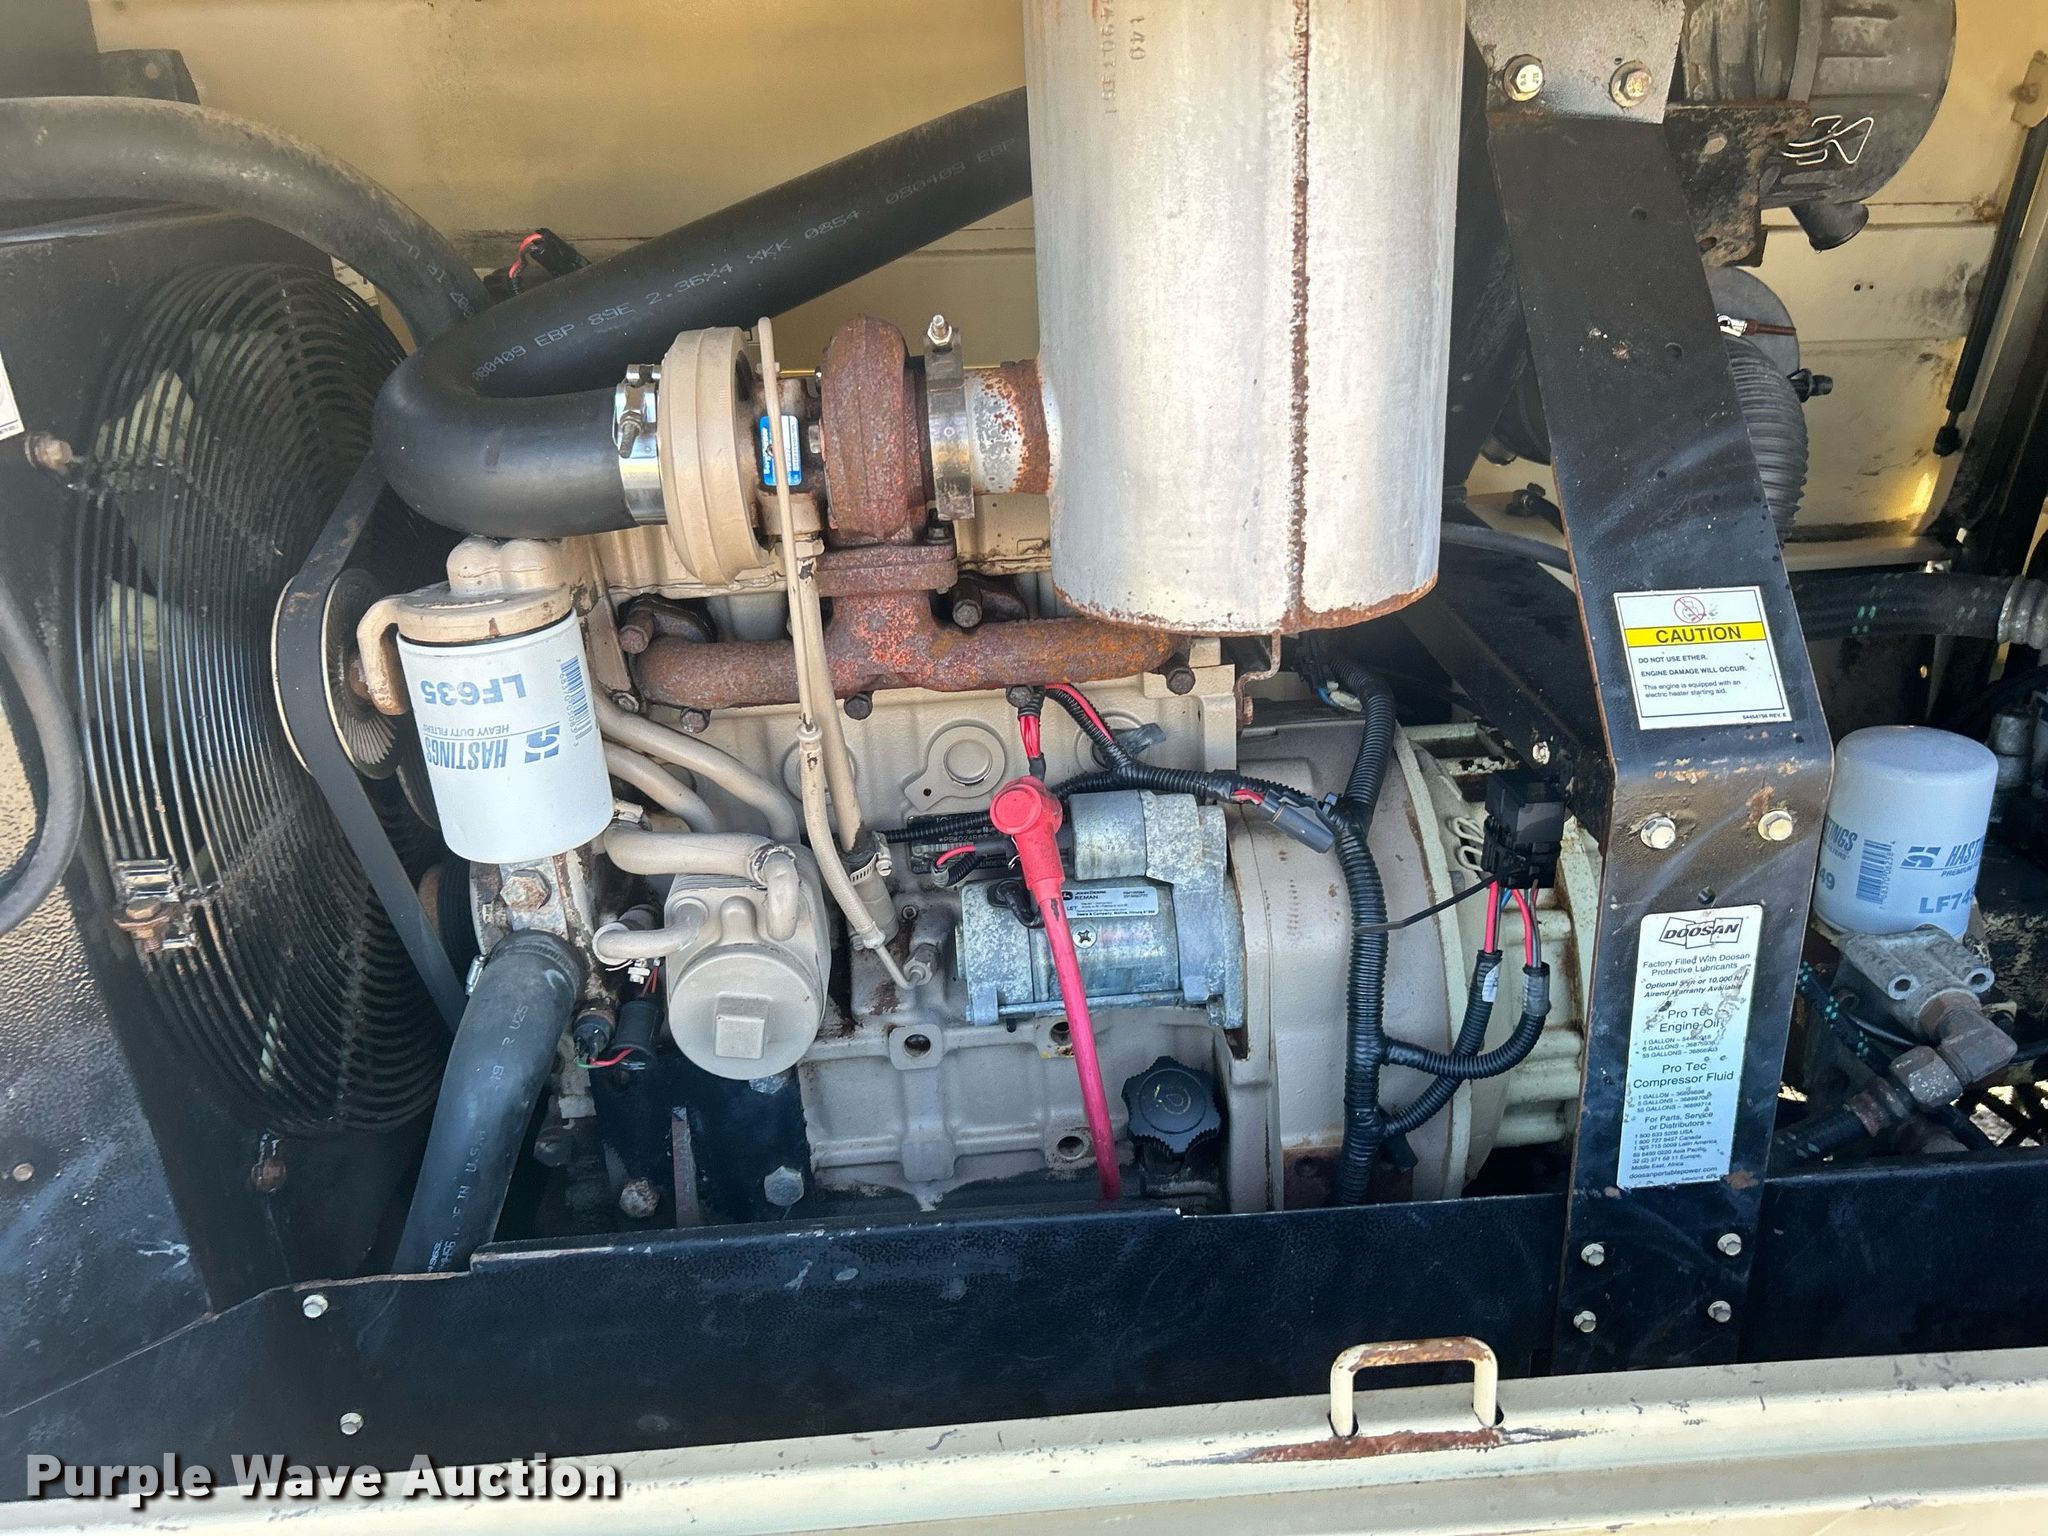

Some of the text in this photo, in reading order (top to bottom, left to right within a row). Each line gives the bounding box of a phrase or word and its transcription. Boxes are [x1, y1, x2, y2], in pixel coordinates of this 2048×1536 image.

[534, 323, 575, 347] EBP
[588, 302, 634, 326] 89E
[1656, 626, 1742, 643] CAUTION
[420, 674, 527, 706] LF635
[1659, 683, 1679, 692] engine
[1688, 680, 1717, 690] equipped
[1690, 688, 1714, 697] starting
[451, 728, 474, 736] DUTY
[478, 724, 509, 736] HEAVY
[425, 737, 508, 770] HASTINGS
[1663, 923, 1740, 940] DOOSAN
[1675, 956, 1697, 965] Filled
[1652, 962, 1738, 976] Protective Lubricants
[1645, 981, 1677, 990] Optional
[1672, 987, 1706, 996] Warranty
[1668, 1007, 1714, 1019] Pro Tec
[1659, 1018, 1719, 1033] Engine Oil
[1662, 1062, 1707, 1074] Pro Tec
[1633, 1071, 1734, 1089] Compressor Fluid
[1660, 1120, 1704, 1129] Distributors
[1629, 1167, 1717, 1178] doosanportablepower.com
